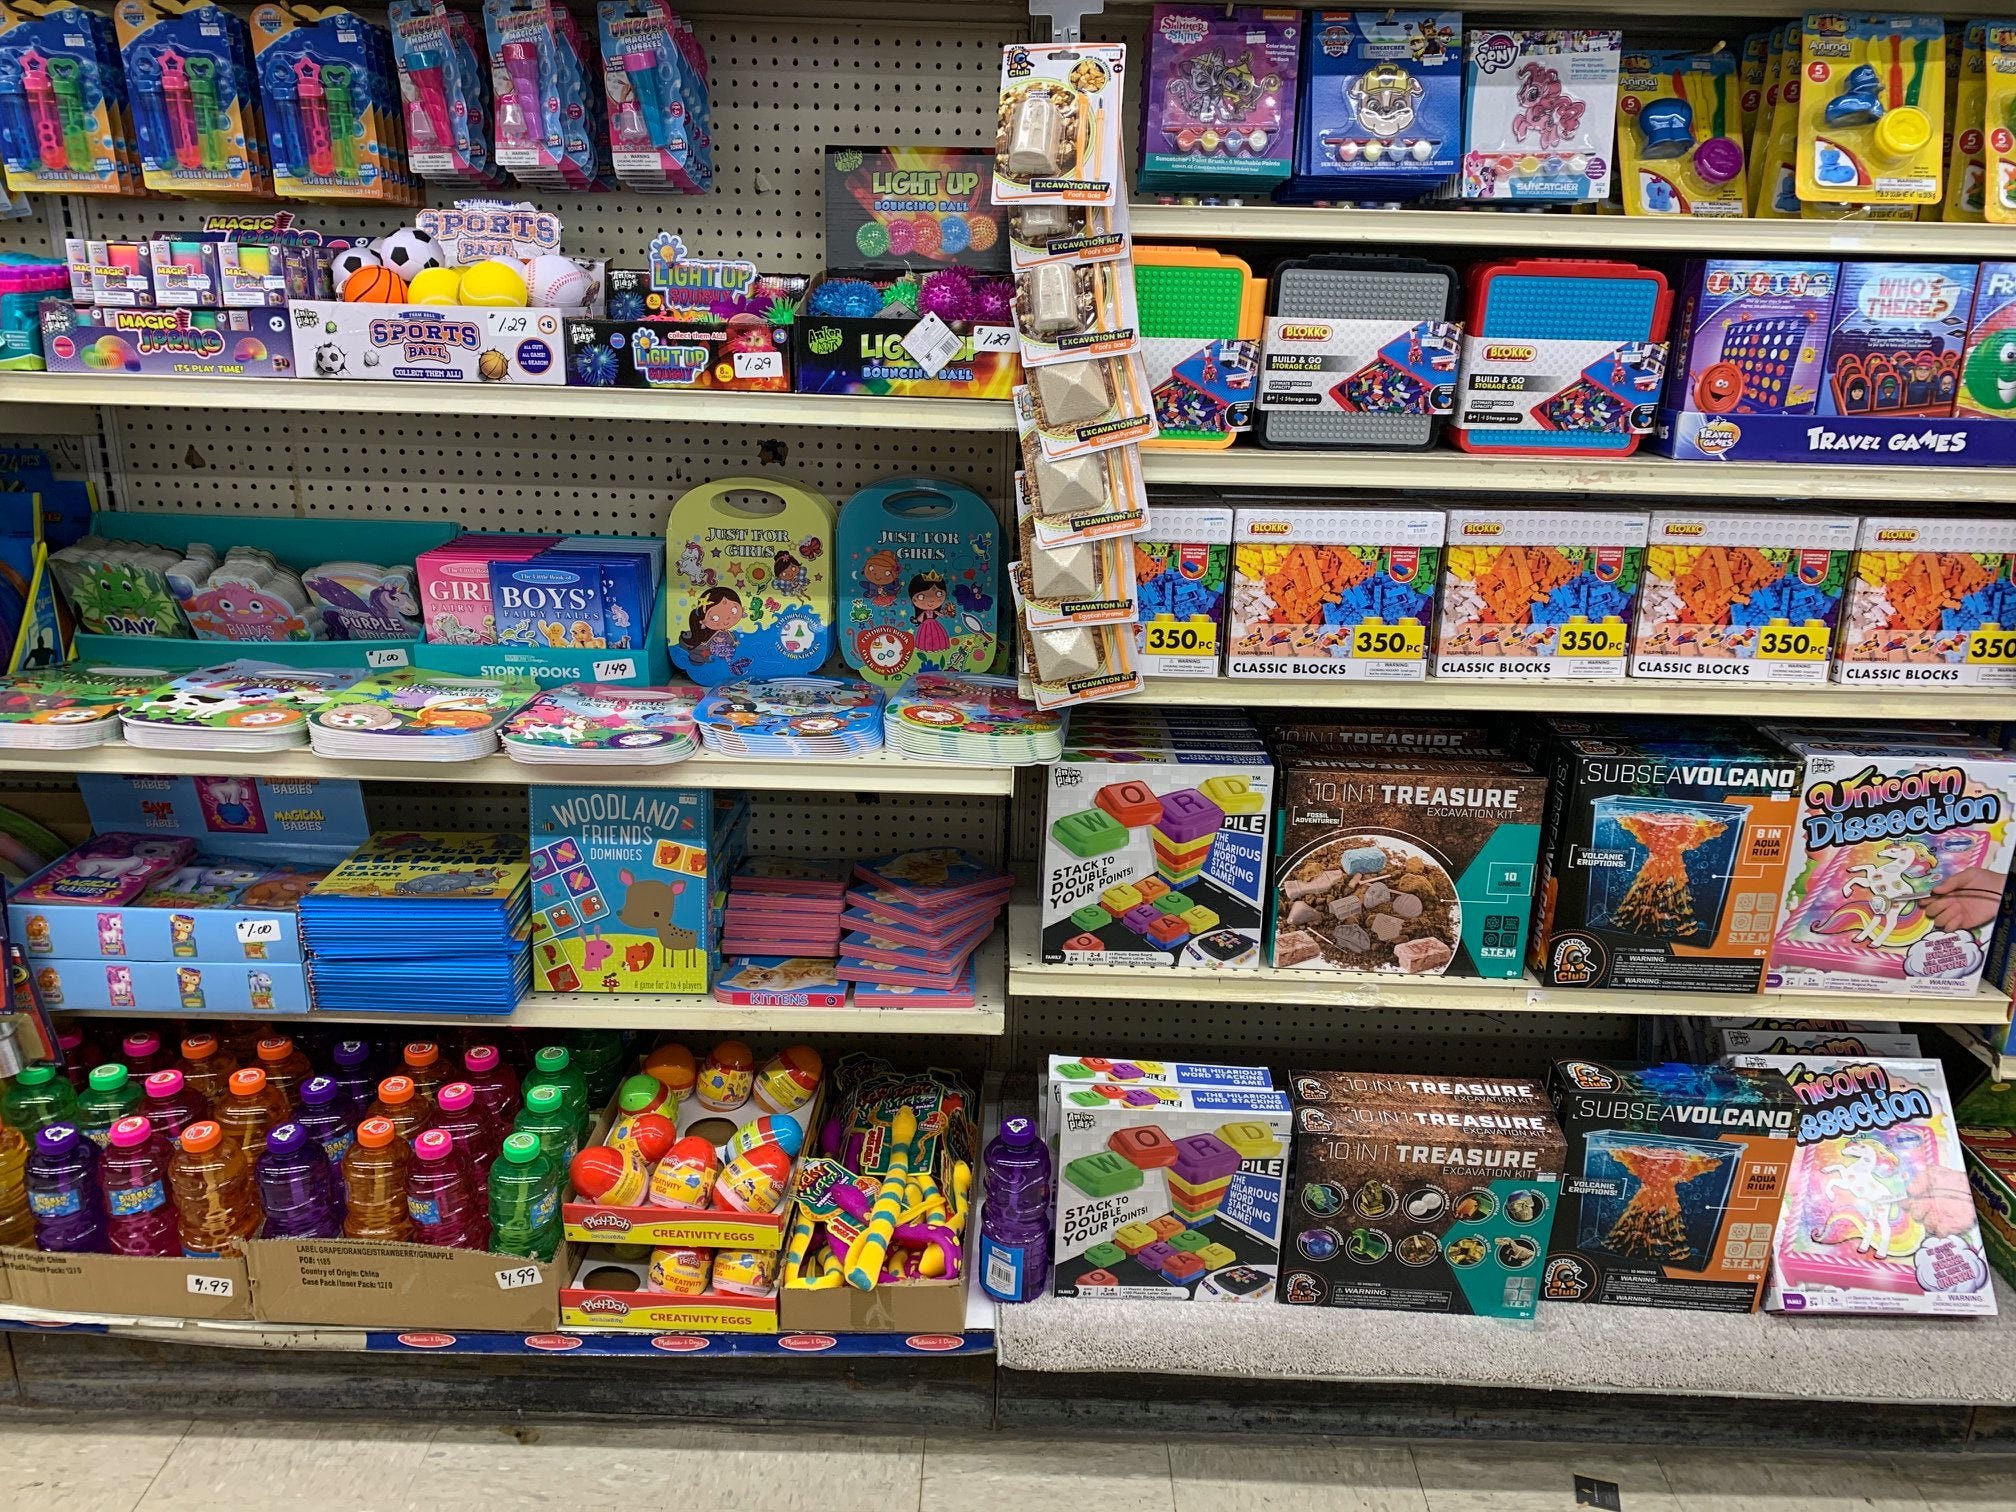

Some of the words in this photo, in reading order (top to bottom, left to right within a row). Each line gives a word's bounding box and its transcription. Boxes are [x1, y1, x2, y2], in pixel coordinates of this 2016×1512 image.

[1809, 41, 1851, 52] Animal
[1477, 49, 1517, 71] PONY
[1009, 68, 1030, 77] Club
[1619, 77, 1658, 88] Animal
[872, 171, 942, 196] LIGHT
[946, 171, 980, 196] UP
[1034, 182, 1092, 191] EXCAVATION
[1092, 183, 1108, 191] KIT
[1516, 182, 1579, 192] SUNCATCHER
[874, 201, 936, 212] BOUNCING
[938, 201, 970, 212] BALL
[208, 216, 277, 231] MAGIC
[417, 208, 560, 247] SPORTS
[1051, 238, 1104, 251] EXCAVATION
[654, 262, 716, 288] LIGHT
[723, 264, 753, 289] UP
[1879, 277, 1944, 297] WHO'S
[1867, 298, 1948, 318] THERE?
[119, 314, 178, 329] MAGIC
[371, 320, 481, 350] SPORTS
[667, 331, 691, 340] collect
[692, 332, 710, 341] them
[1286, 325, 1332, 339] BLOKKO
[1061, 334, 1112, 346] EXCAVATION
[1489, 346, 1536, 359] BLOKKO
[1272, 356, 1297, 364] BUILD
[1299, 356, 1306, 364] &
[1307, 356, 1322, 364] GO
[191, 364, 216, 374] PLAY
[217, 365, 244, 374] TIME!
[394, 368, 424, 378] COLLECT
[424, 369, 442, 378] THEM
[442, 370, 462, 379] ALL!
[1474, 382, 1506, 390] STORAGE
[1475, 376, 1500, 384] BUILD
[1502, 376, 1509, 384] &
[1511, 376, 1525, 384] GO
[1703, 437, 1734, 447] GAMES
[1808, 425, 1881, 452] TRAVEL
[1888, 429, 1966, 452] GAMES
[1253, 523, 1290, 533] BLOKKO
[1466, 524, 1502, 534] BLOKKO
[705, 527, 748, 542] JUST
[751, 529, 791, 543] FOR
[877, 530, 920, 545] JUST
[923, 531, 960, 545] FOR
[724, 544, 775, 558] GIRLS
[896, 547, 946, 560] GIRLS
[501, 587, 595, 610] BOYS'
[431, 604, 474, 612] FAIRY
[503, 610, 548, 619] FAIRY
[554, 611, 599, 619] TALES
[106, 616, 159, 636] DAVY
[342, 618, 403, 632] PURPLE
[1149, 629, 1198, 650] 350
[1198, 640, 1213, 651] PC
[1356, 632, 1405, 653] 350
[1406, 643, 1421, 653] PC
[1561, 630, 1609, 651] 350
[1609, 641, 1622, 651] PC
[1810, 645, 1825, 655] PC
[480, 665, 525, 677] STORY
[531, 667, 581, 679] BOOKS
[1233, 662, 1289, 674] CLASSIC
[1292, 663, 1347, 675] BLOCKS
[1441, 662, 1495, 673] CLASSIC
[1499, 662, 1552, 673] BLOCKS
[1638, 661, 1692, 673] CLASSIC
[1697, 664, 1750, 675] BLOCKS
[1846, 668, 1901, 680] CLASSIC
[1905, 669, 1959, 681] BLOCKS
[132, 779, 171, 791] BABIES
[272, 783, 313, 795] BABIES
[1807, 766, 1963, 812] Unicorn
[1313, 782, 1337, 802] 10
[1342, 783, 1364, 803] IN
[1381, 784, 1520, 809] TREASURE
[274, 809, 325, 822] MAGICAL
[551, 793, 680, 832] WOODLAND
[1224, 816, 1263, 832] PILE
[1295, 817, 1340, 826] ADVENTURES!
[1806, 795, 1998, 849] Dissection
[582, 825, 654, 846] FRIENDS
[1216, 832, 1229, 843] THE
[1766, 829, 1782, 839] IN
[1753, 839, 1780, 849] AQUA
[590, 847, 643, 862] DOMINOES
[1213, 849, 1237, 864] WORD
[1215, 840, 1261, 862] HILARIOUS
[1581, 851, 1624, 861] VOLCANIC
[1752, 848, 1780, 857] RIUM
[352, 853, 523, 866] ELEPHANT
[1577, 858, 1626, 868] ERUPTIONS!
[1052, 858, 1099, 881] STACK
[1102, 855, 1115, 866] TO
[1211, 858, 1254, 883] STACKING
[1052, 867, 1108, 895] DOUBLE
[1210, 867, 1236, 886] GAME!
[1050, 883, 1094, 910] YOUR
[1099, 867, 1134, 888] POINTS!
[1629, 955, 1667, 963] WARNING:
[1557, 970, 1587, 981] Club
[640, 982, 654, 991] game
[655, 982, 664, 990] for
[682, 980, 703, 992] players
[749, 993, 809, 1006] KITTENS
[1406, 1081, 1534, 1099] TREASURE
[1204, 1092, 1223, 1100] THE
[1226, 1093, 1282, 1102] HILARIOUS
[1414, 1112, 1545, 1131] TREASURE
[1396, 1144, 1540, 1169] TREASURE
[1241, 1160, 1282, 1175] PILE
[1573, 1180, 1615, 1190] VOLCANIC
[1749, 1175, 1776, 1184] AQUA
[1568, 1186, 1618, 1196] ERUPTIONS!
[1747, 1183, 1775, 1191] RIUM
[1065, 1199, 1113, 1220] STACK
[1115, 1196, 1129, 1206] TO
[1228, 1199, 1271, 1223] STACKING
[1063, 1222, 1108, 1247] YOUR
[1113, 1206, 1149, 1225] POINTS!
[1064, 1206, 1122, 1234] DOUBLE
[652, 1228, 721, 1241] CREATIVITY
[722, 1231, 755, 1242] EGGS
[46, 1256, 67, 1264] China
[300, 1267, 327, 1276] Country
[336, 1268, 358, 1277] Origin:
[360, 1270, 380, 1278] China
[664, 1274, 702, 1288] CREATIVITY
[674, 1285, 690, 1293] EGG
[1548, 1288, 1578, 1297] Club
[650, 1312, 719, 1325] CREATIVITY
[721, 1314, 752, 1326] EGGS
